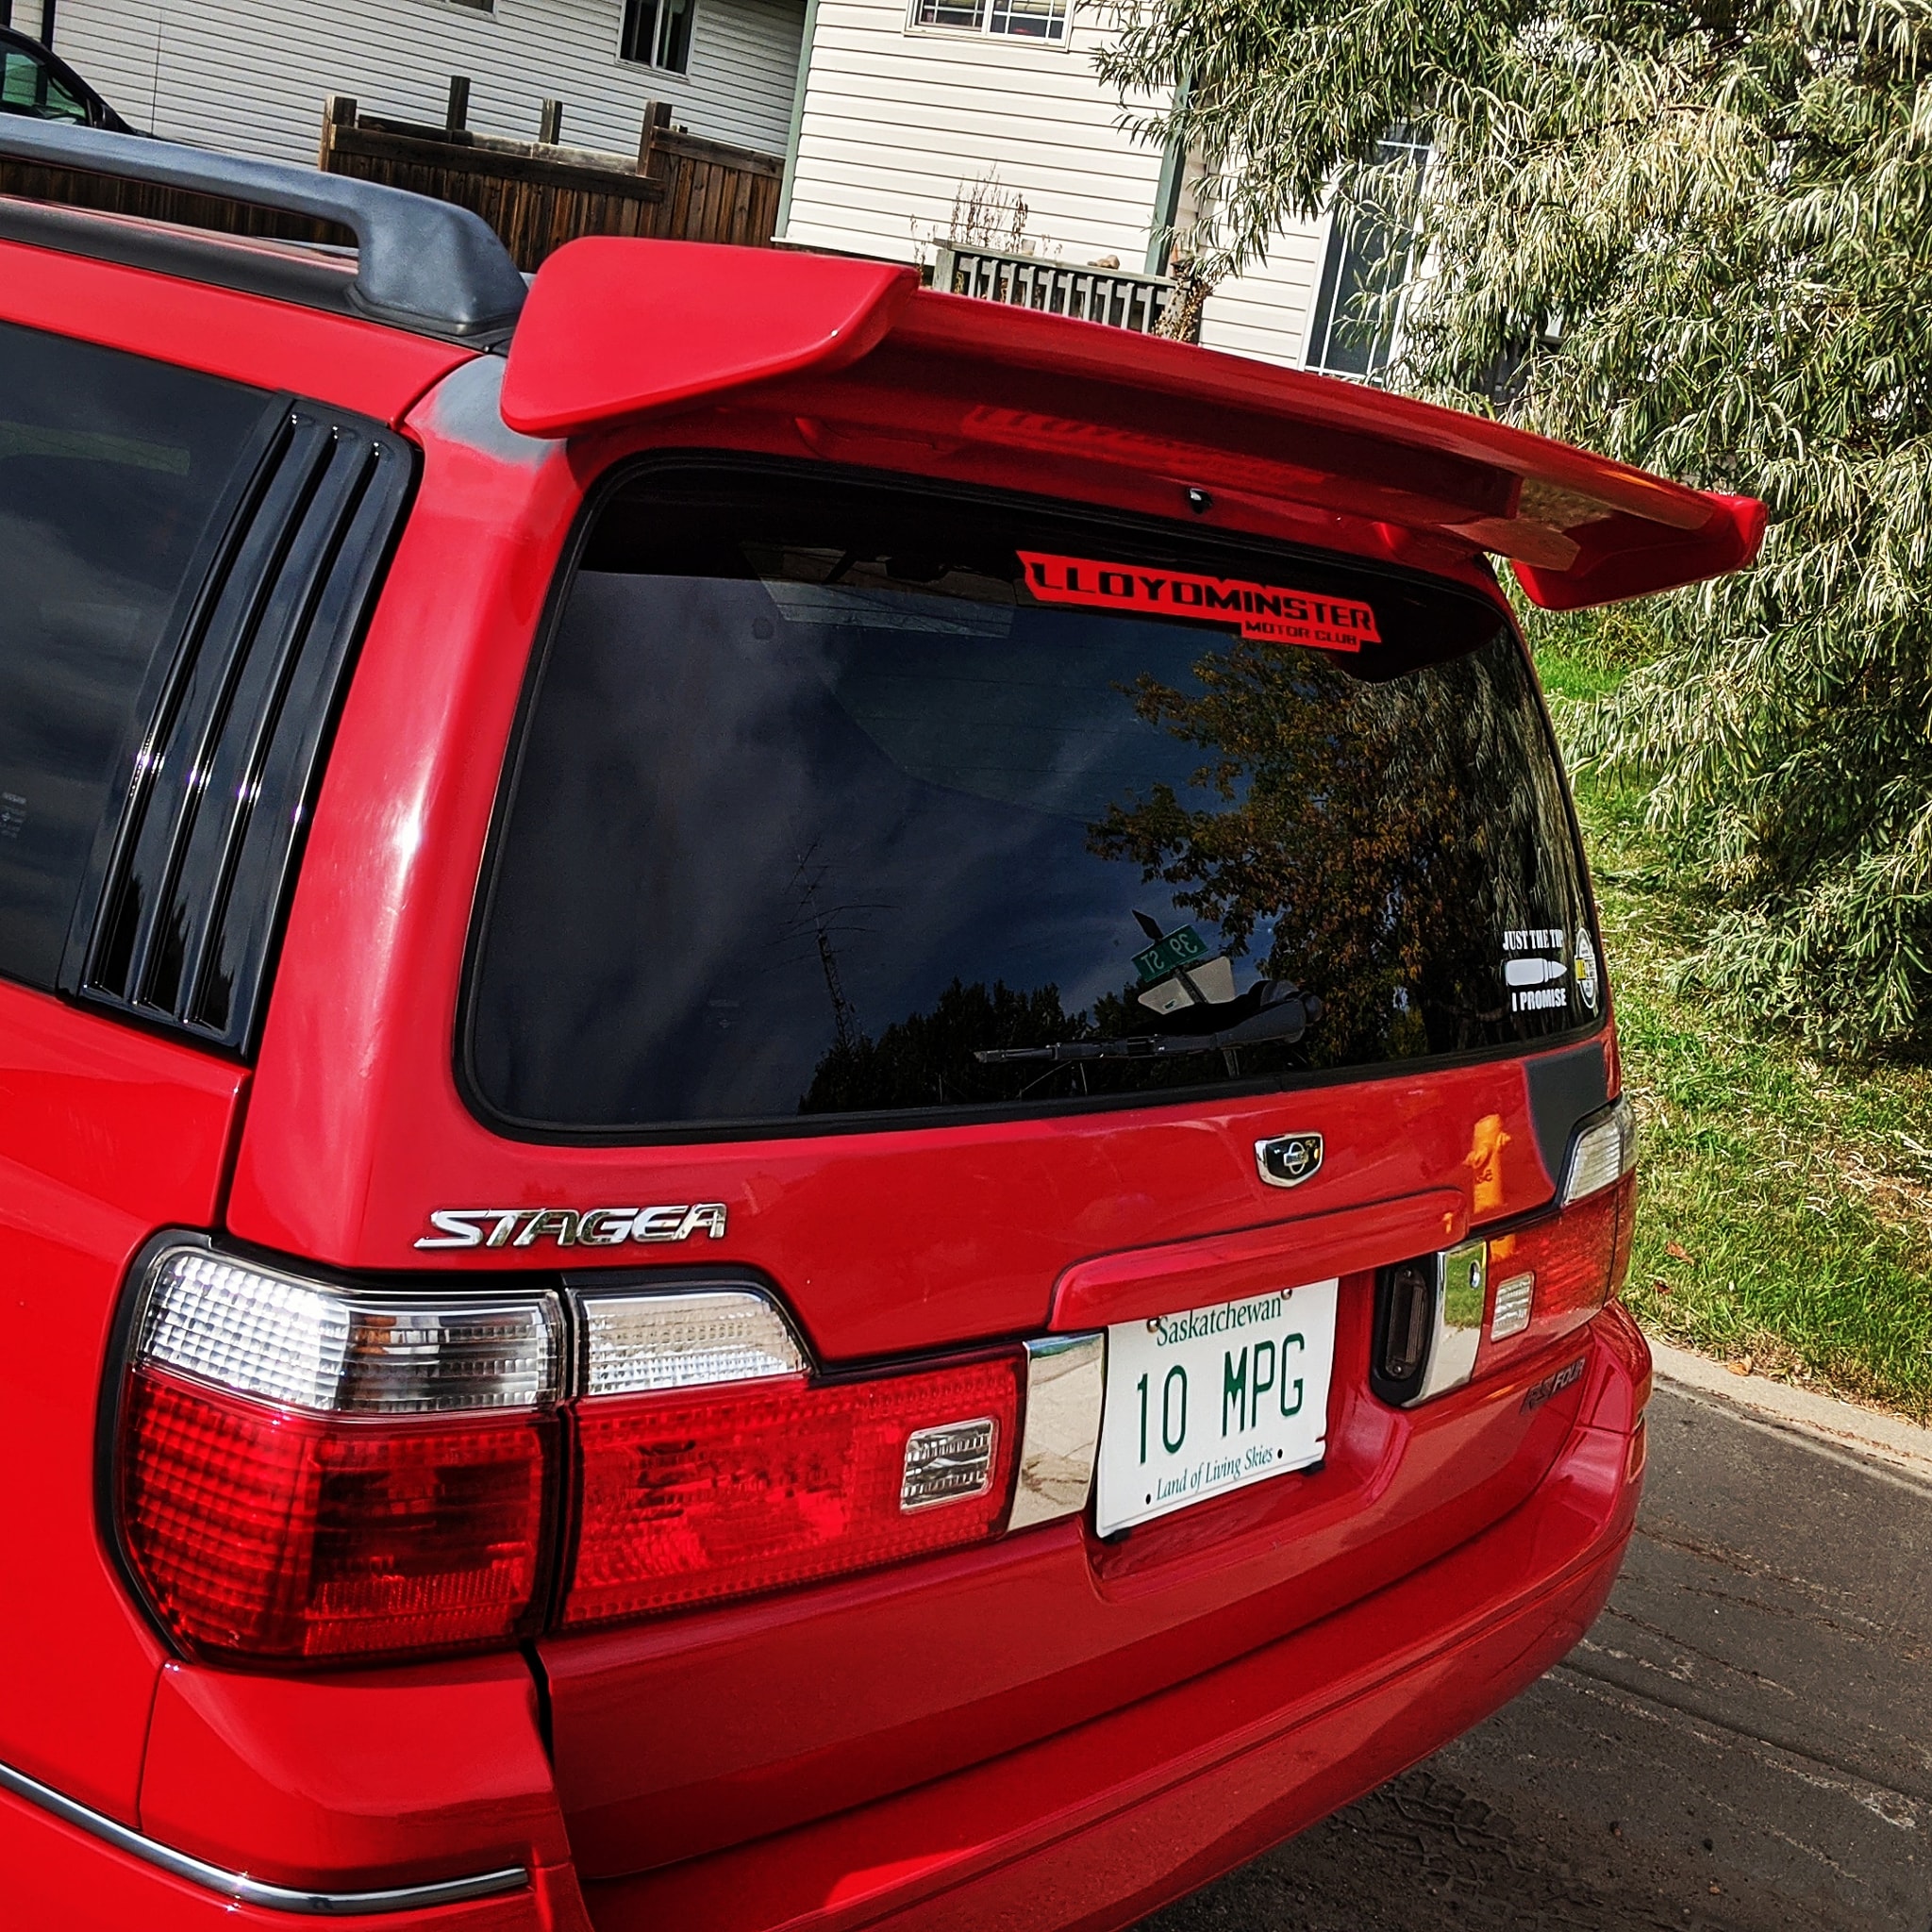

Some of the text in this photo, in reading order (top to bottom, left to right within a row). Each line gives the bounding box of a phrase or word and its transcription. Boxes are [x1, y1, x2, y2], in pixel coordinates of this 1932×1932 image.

[1245, 620, 1357, 646] MOTOR CLUB
[1503, 930, 1528, 951] JUST
[1529, 929, 1550, 949] THE
[1511, 988, 1567, 1012] I PROMISE
[413, 1203, 728, 1250] STAGEA
[1157, 1296, 1282, 1347] Saskatchewan
[1136, 1331, 1306, 1467] 10 MPG
[1157, 1444, 1274, 1501] Land of Living Skies
